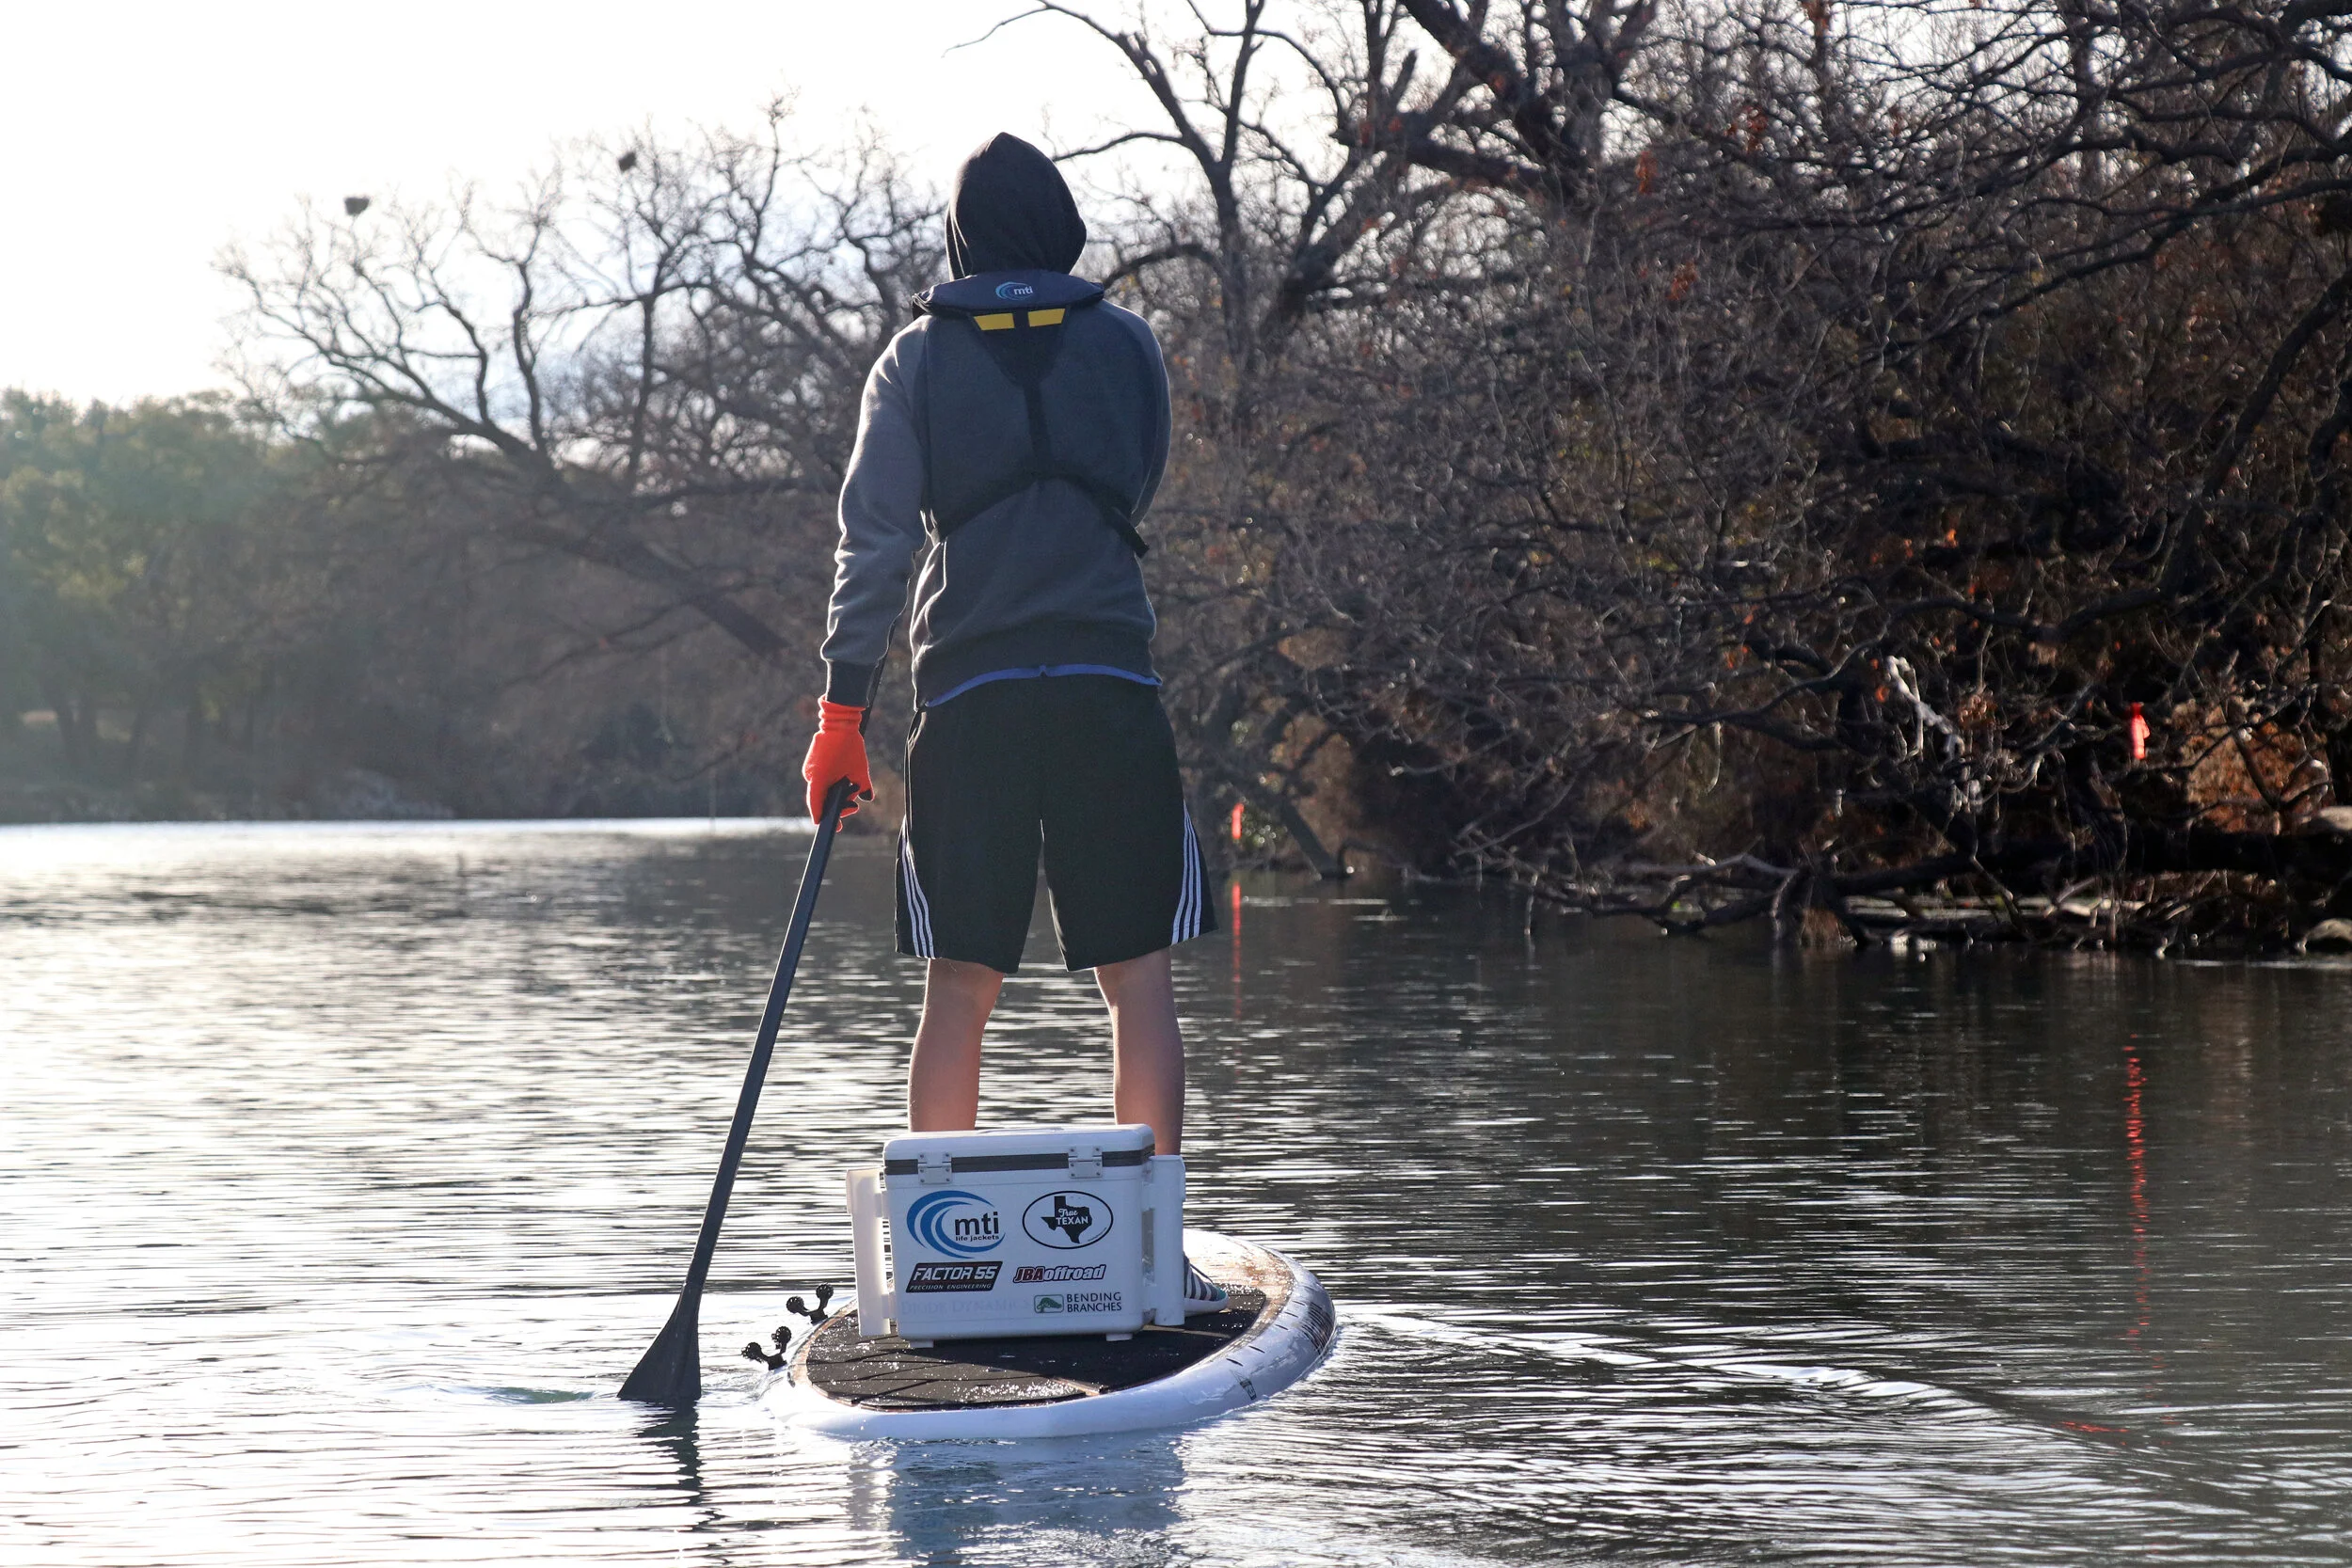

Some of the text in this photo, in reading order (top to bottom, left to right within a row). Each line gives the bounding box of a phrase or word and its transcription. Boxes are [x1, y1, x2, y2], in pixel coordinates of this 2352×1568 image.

[1013, 285, 1034, 295] mti
[1057, 1208, 1079, 1217] True
[955, 1211, 999, 1236] mti
[1056, 1216, 1089, 1226] TEXAN
[913, 1265, 997, 1281] FACTOR 55
[1066, 1292, 1121, 1302] BENDING
[1067, 1303, 1122, 1312] BRANCHES
